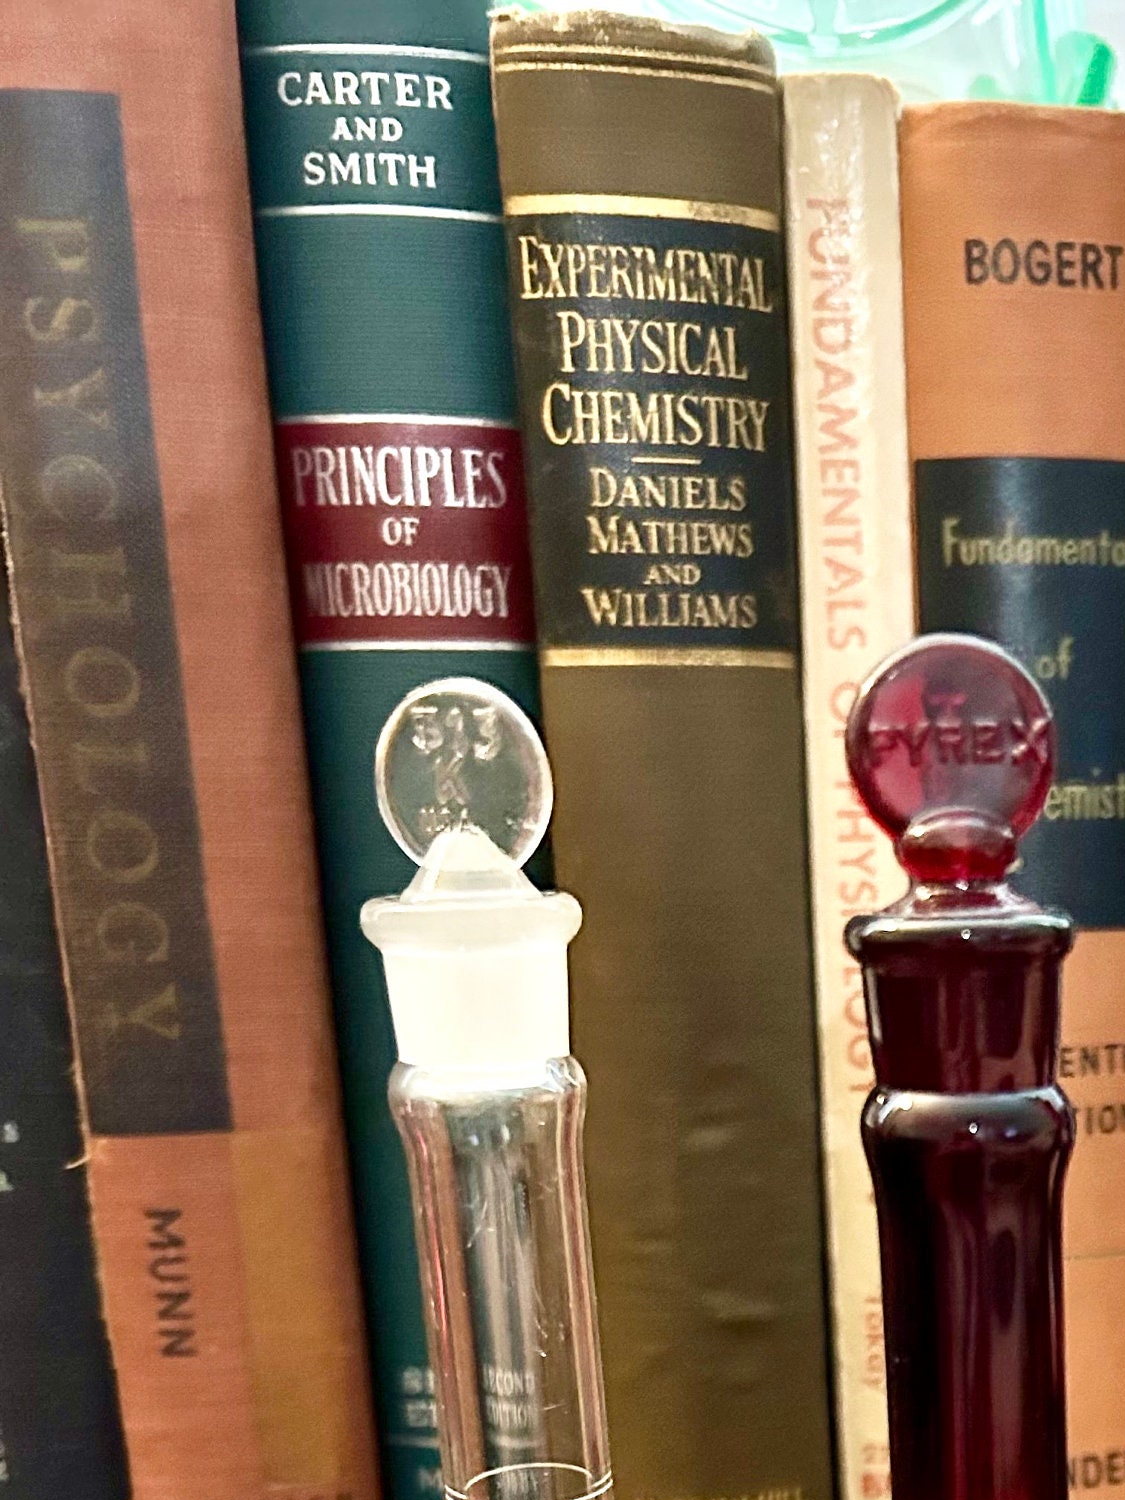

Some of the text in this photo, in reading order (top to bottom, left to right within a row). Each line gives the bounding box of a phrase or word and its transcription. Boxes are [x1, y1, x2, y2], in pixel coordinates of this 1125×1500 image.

[277, 71, 453, 112] CARTER
[332, 117, 404, 142] AND
[303, 153, 437, 189] SMITH
[518, 235, 773, 313] EXPERIMENTAL
[964, 238, 1125, 291] BOGERT
[559, 311, 748, 381] PHYSICAL
[541, 383, 769, 453] CHEMISTRY
[804, 196, 867, 652] FUNDAMENTALS
[292, 445, 507, 508] PRINCIPLES
[590, 469, 746, 511] DANIELS
[381, 516, 420, 546] OF
[588, 517, 754, 558] MATHEWS
[304, 563, 511, 617] MICROBIOLOGY
[643, 563, 701, 587] AND
[14, 215, 182, 1041] PSYCHOLOGY
[580, 588, 758, 629] WILLIAMS
[1036, 639, 1073, 681] of
[868, 715, 1053, 768] PYREX
[144, 1207, 198, 1360] MUNN
